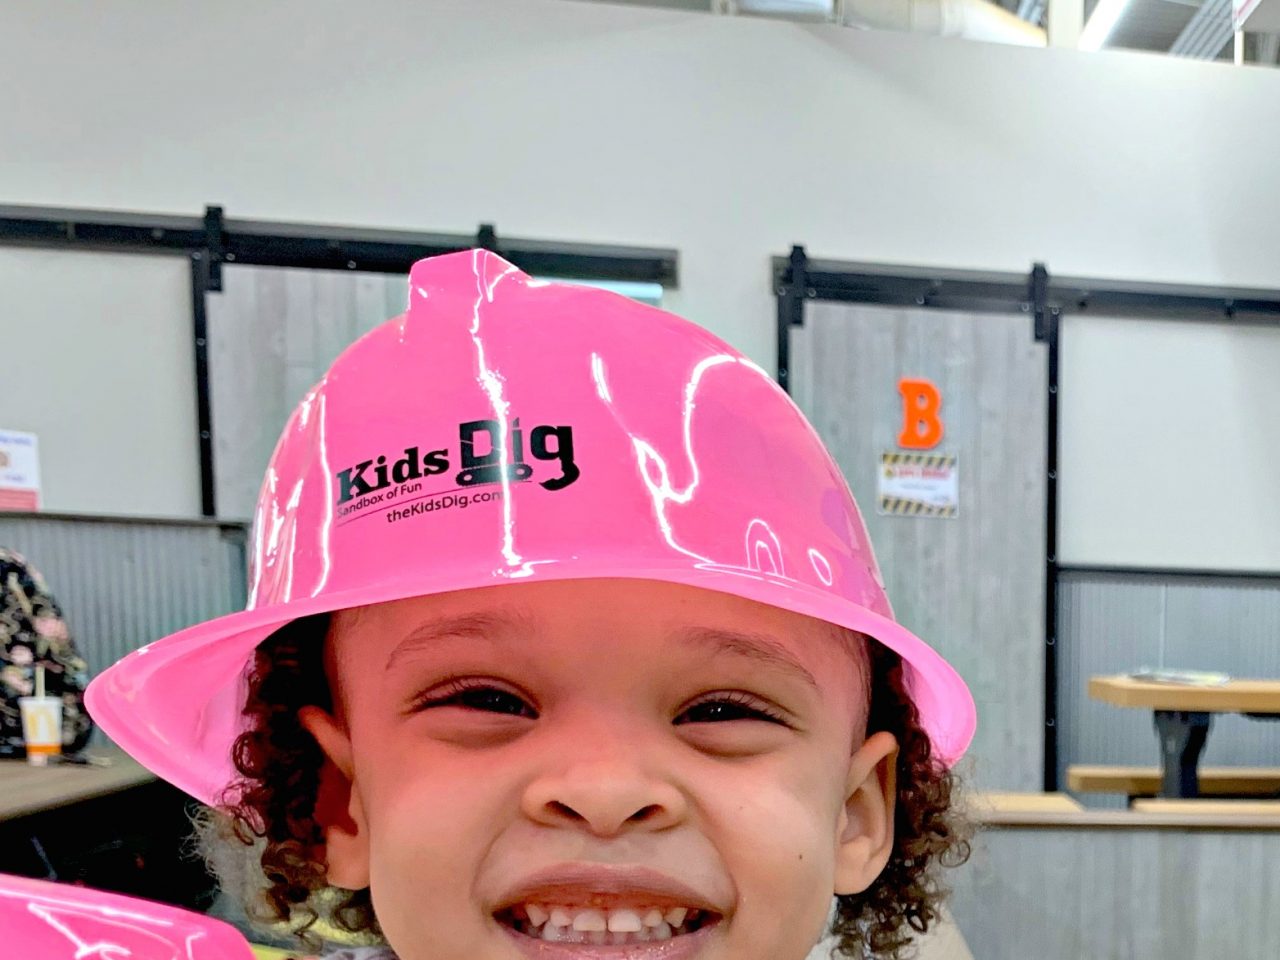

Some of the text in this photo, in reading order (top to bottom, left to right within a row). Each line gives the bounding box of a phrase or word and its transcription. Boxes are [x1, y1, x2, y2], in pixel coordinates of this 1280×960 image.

[896, 378, 944, 450] B
[336, 417, 580, 506] Kids Dig
[336, 481, 423, 518] Sandbox of Fun
